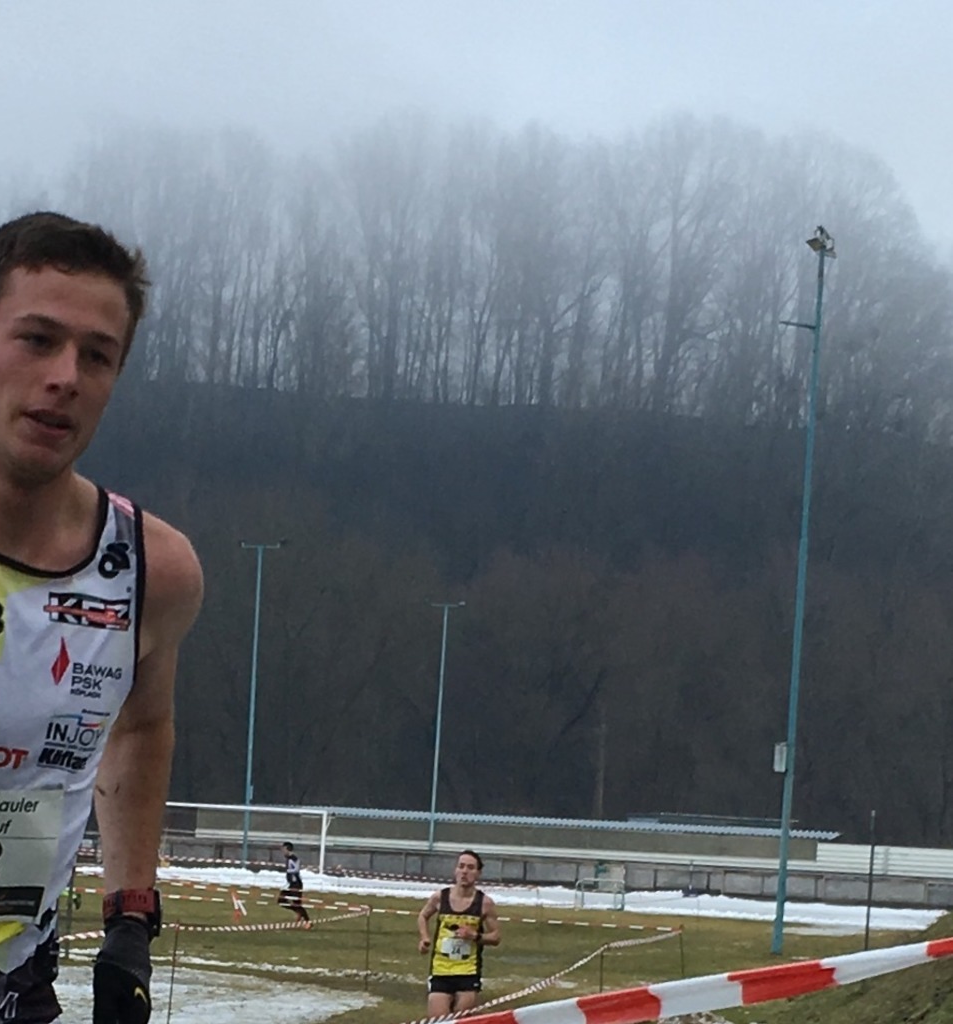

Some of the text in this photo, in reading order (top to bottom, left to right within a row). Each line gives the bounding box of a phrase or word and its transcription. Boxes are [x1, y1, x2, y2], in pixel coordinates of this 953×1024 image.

[72, 662, 122, 680] BAWAG
[71, 676, 103, 691] PSK
[45, 722, 105, 747] INJOY
